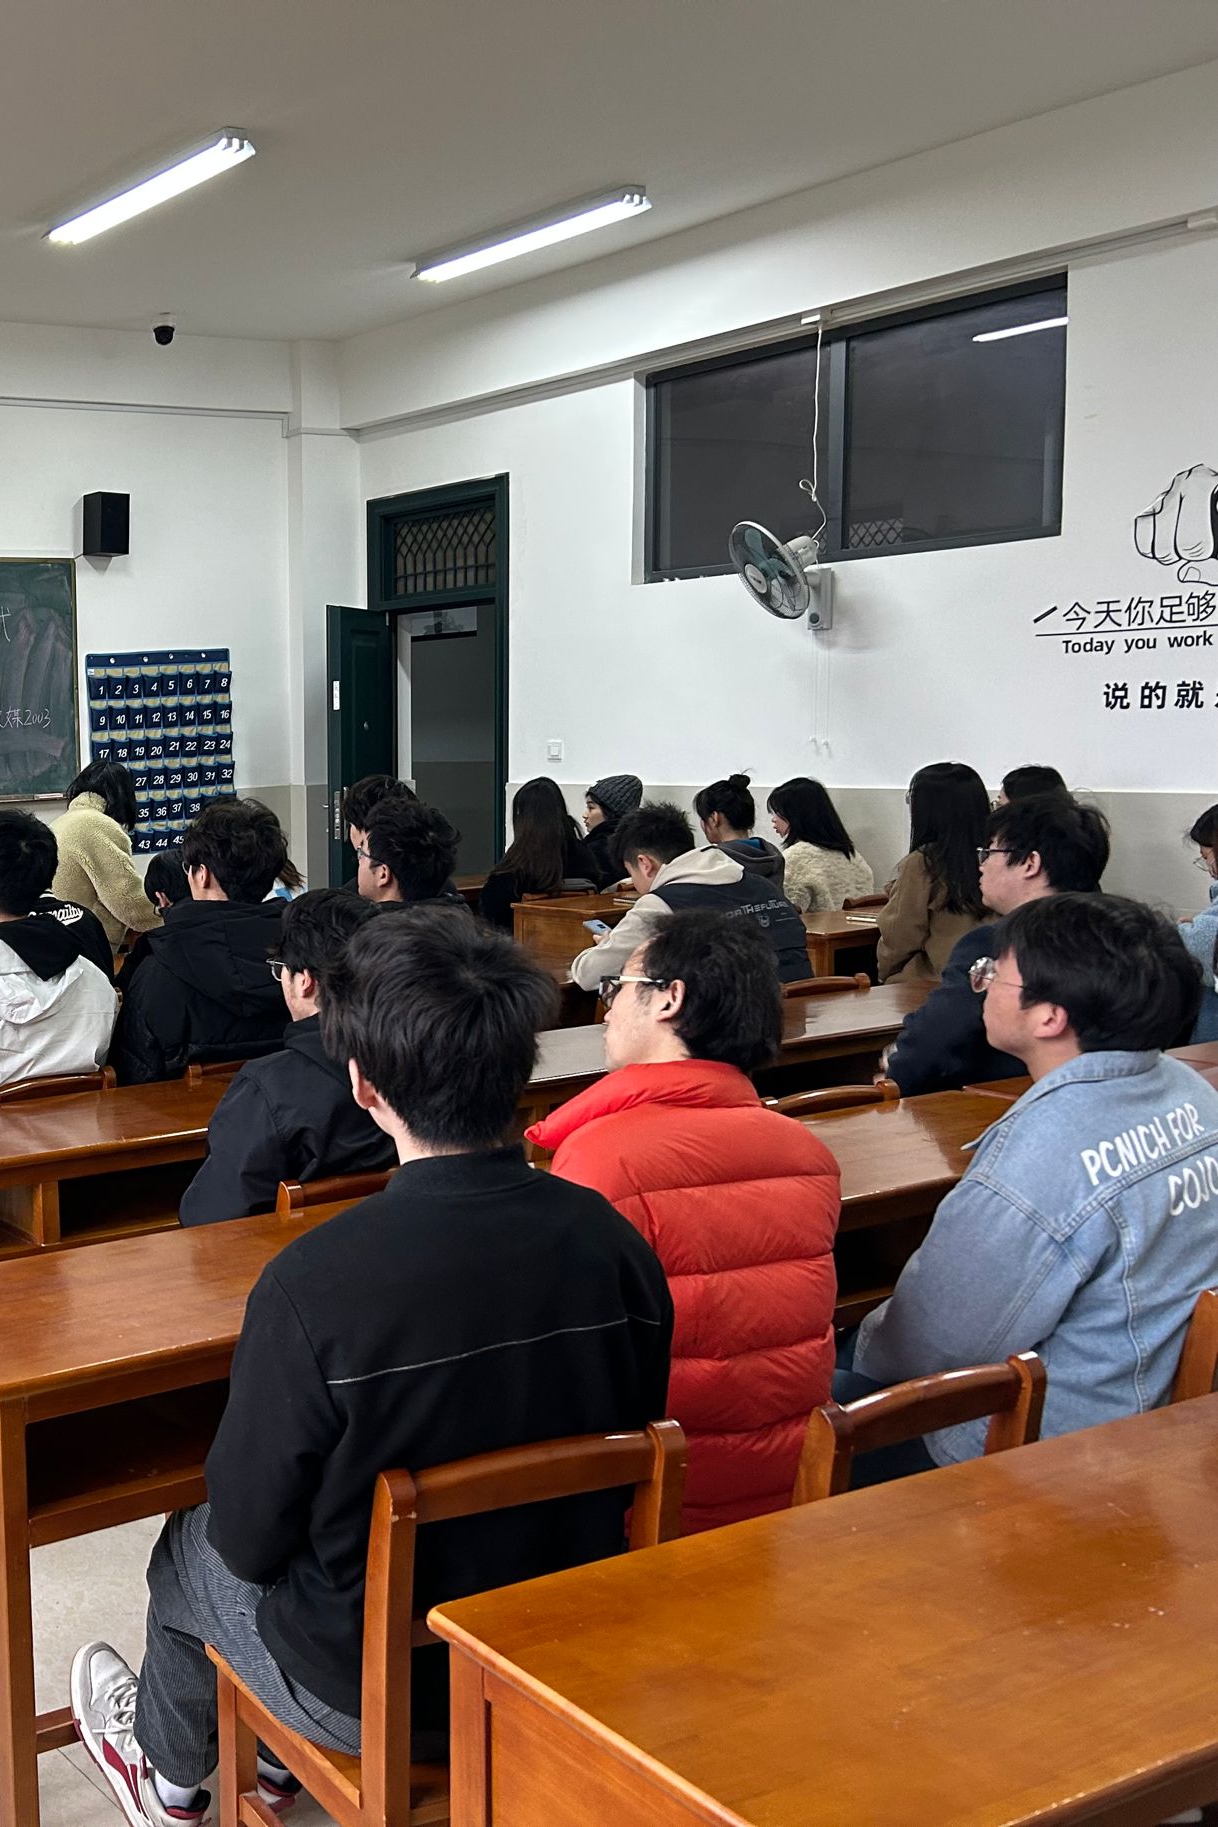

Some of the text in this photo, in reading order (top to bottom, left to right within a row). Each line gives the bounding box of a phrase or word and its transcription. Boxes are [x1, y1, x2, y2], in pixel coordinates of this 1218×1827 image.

[1062, 590, 1217, 631] 今天你足够
[1062, 630, 1214, 655] Today you work
[98, 678, 227, 694] 1 2 3 4 5 6 7 8
[1103, 681, 1218, 710] 说的就
[99, 710, 230, 725] 9 10 11 12 13 14 15 16
[98, 740, 230, 758] 17 18 19 20 21 22 23 24
[135, 769, 232, 786] 27 28 29 30 31 32
[137, 803, 200, 817] 35 36 37 38
[137, 840, 150, 848] 43
[1166, 1102, 1205, 1146] FOR
